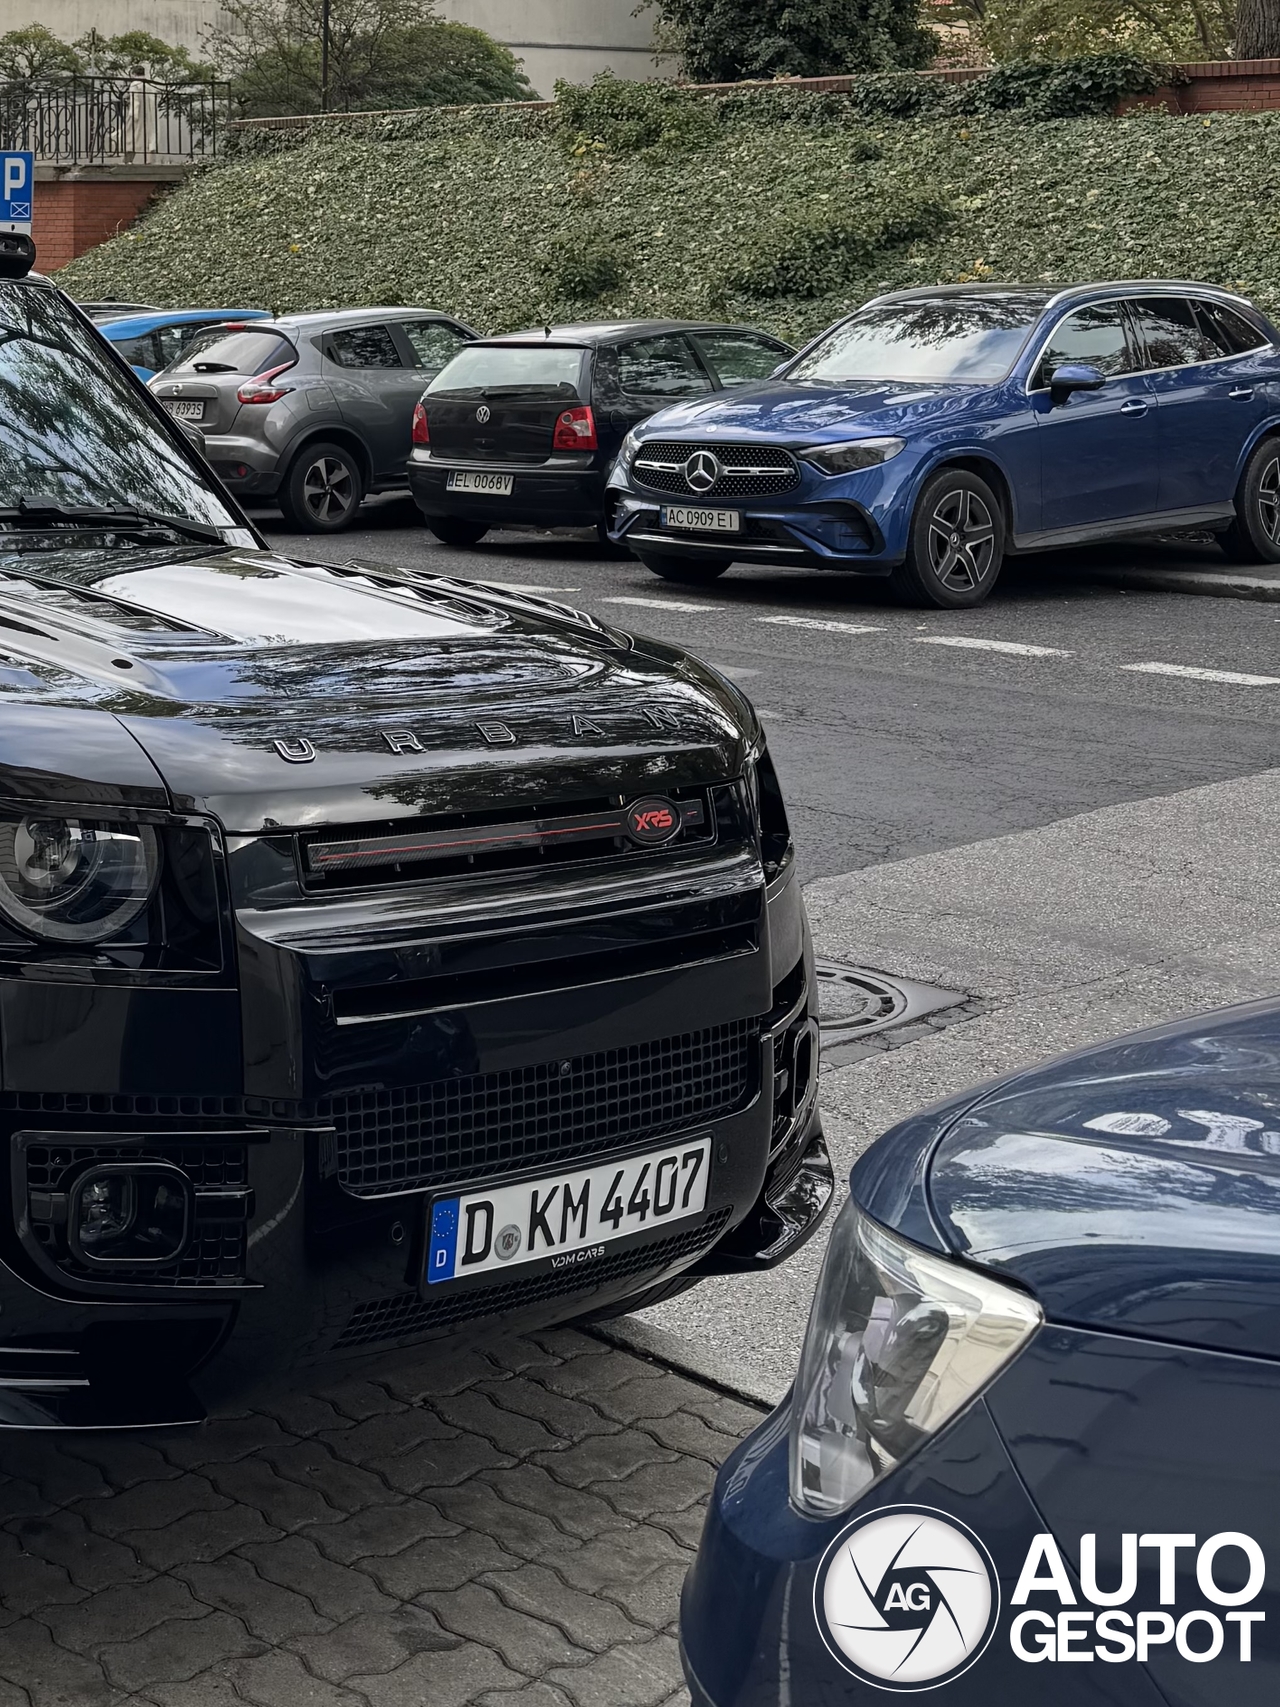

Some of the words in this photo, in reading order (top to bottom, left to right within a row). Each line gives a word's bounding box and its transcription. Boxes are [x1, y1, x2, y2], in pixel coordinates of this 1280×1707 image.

[4, 157, 26, 201] P
[175, 402, 202, 415] 6393S
[455, 473, 470, 487] EL
[474, 474, 511, 491] 0068V
[669, 508, 684, 524] AC
[686, 510, 714, 527] 0909
[274, 706, 681, 763] URBAN
[634, 809, 673, 832] XRS
[461, 1200, 495, 1266] D
[527, 1177, 591, 1253] KM
[599, 1147, 705, 1231] 4407
[435, 1249, 447, 1268] D
[576, 1245, 606, 1262] CARS
